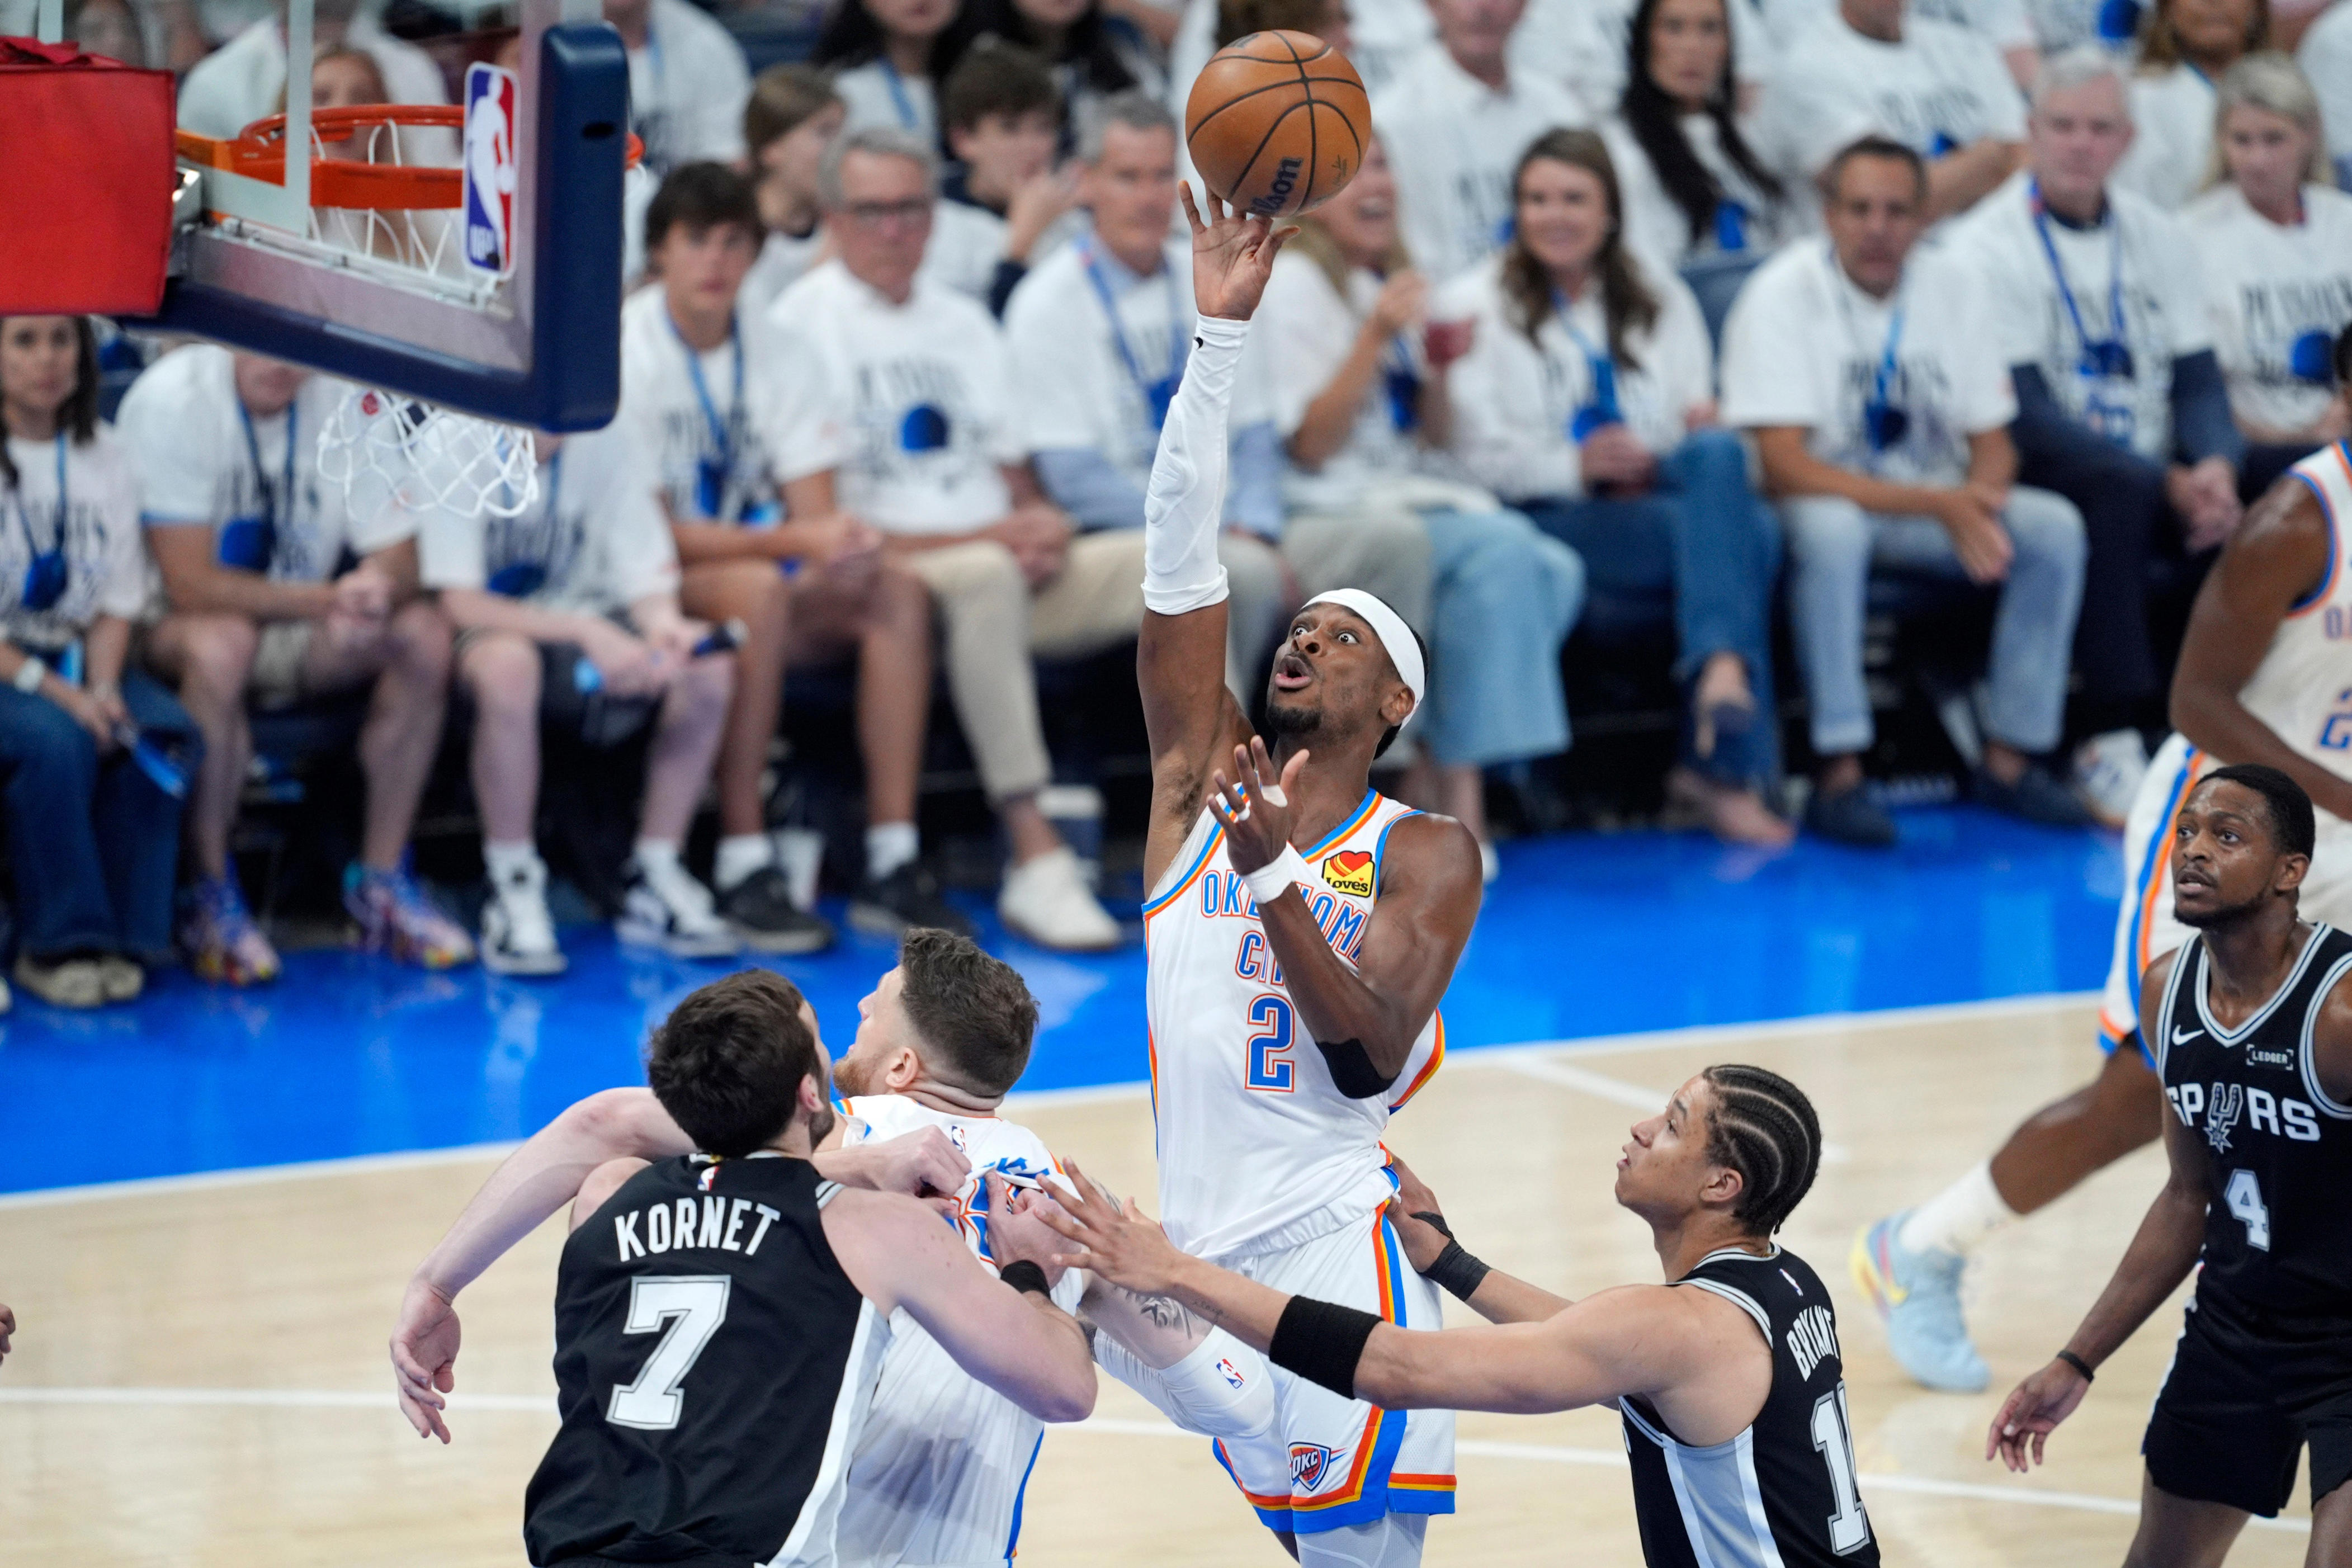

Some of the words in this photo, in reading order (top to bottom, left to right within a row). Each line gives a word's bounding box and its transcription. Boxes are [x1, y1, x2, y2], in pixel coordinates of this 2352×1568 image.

[1245, 993, 1295, 1093] 2
[2252, 1050, 2288, 1064] LEDGER
[615, 1196, 781, 1263] KORNET
[2223, 1168, 2270, 1252] 4
[606, 1274, 731, 1430] 7
[1787, 1305, 1839, 1382] BRYANT
[1291, 1450, 1319, 1480] OKC
